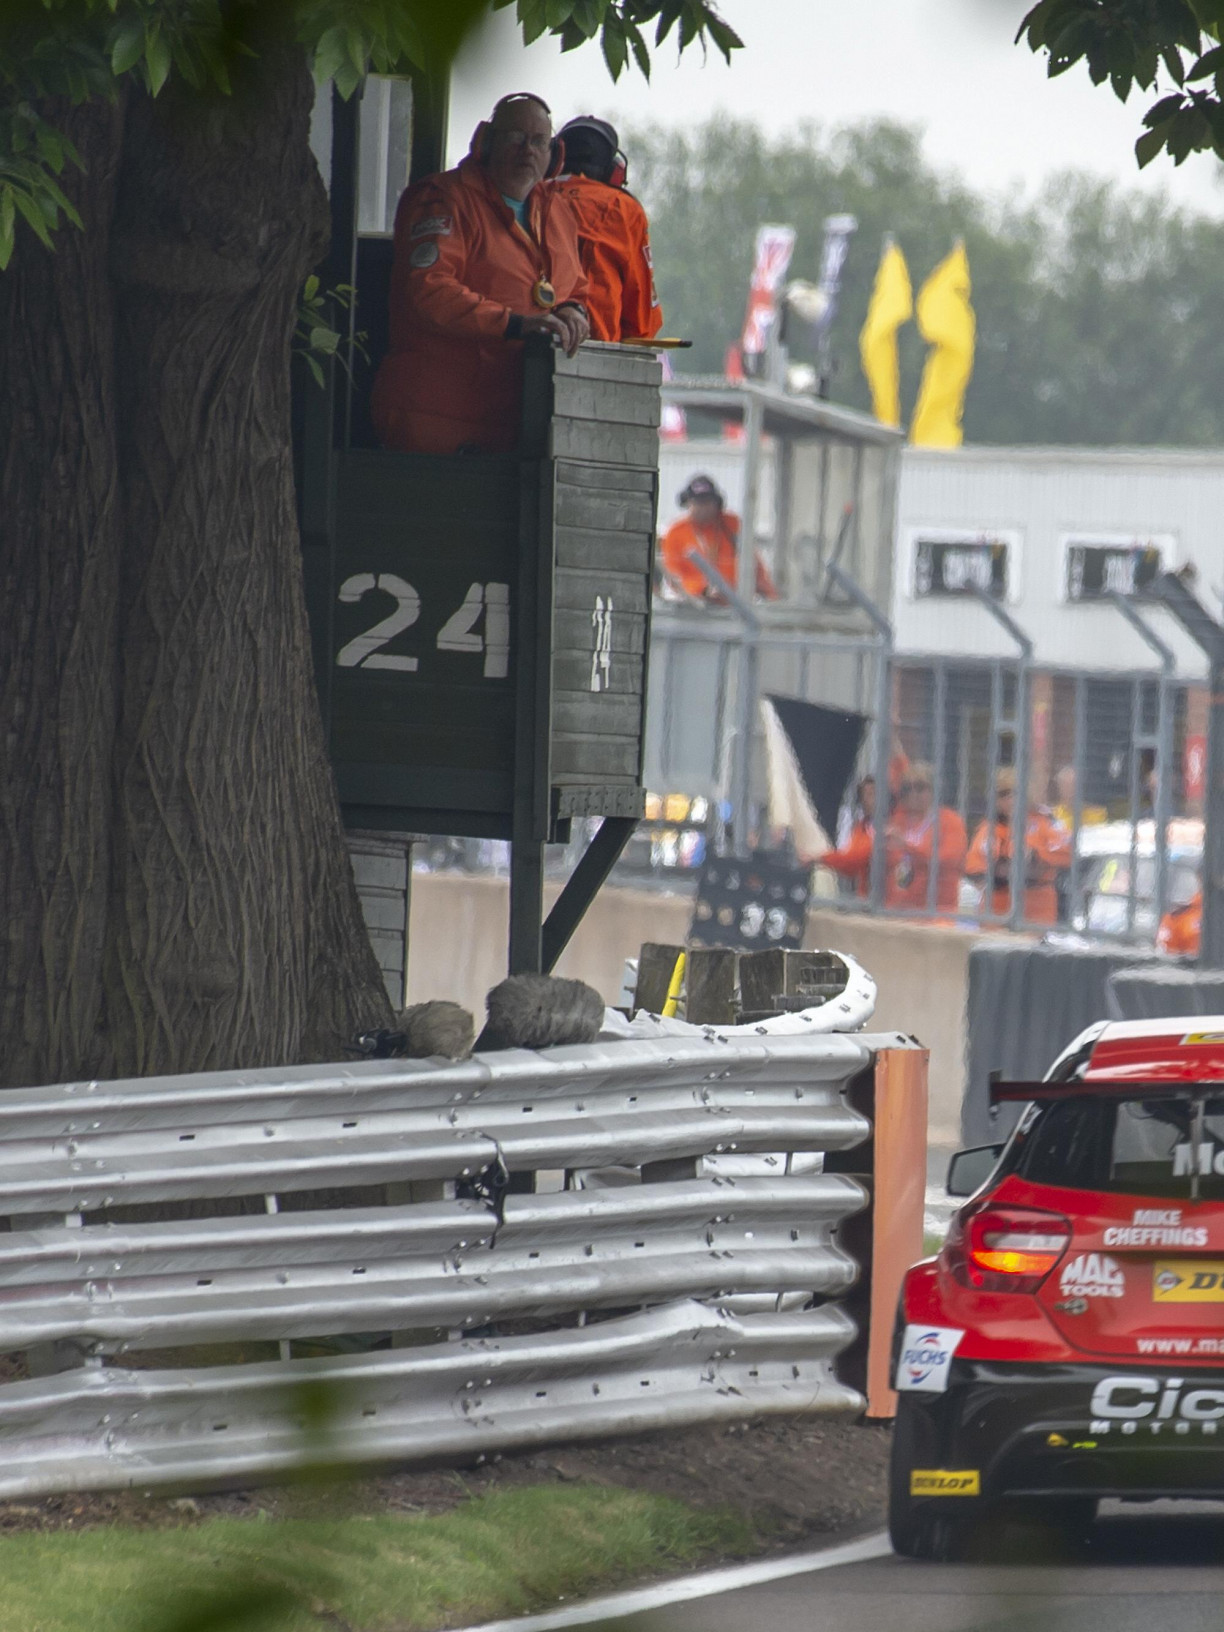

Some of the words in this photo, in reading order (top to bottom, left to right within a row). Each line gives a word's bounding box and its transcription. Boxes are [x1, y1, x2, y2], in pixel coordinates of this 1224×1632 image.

[336, 572, 510, 678] 24
[1133, 1209, 1183, 1226] MIKE
[1103, 1227, 1209, 1246] CHEFFINGS
[1061, 1253, 1125, 1285] MAC
[1061, 1284, 1125, 1298] TOOLS
[902, 1350, 948, 1366] FUCHS
